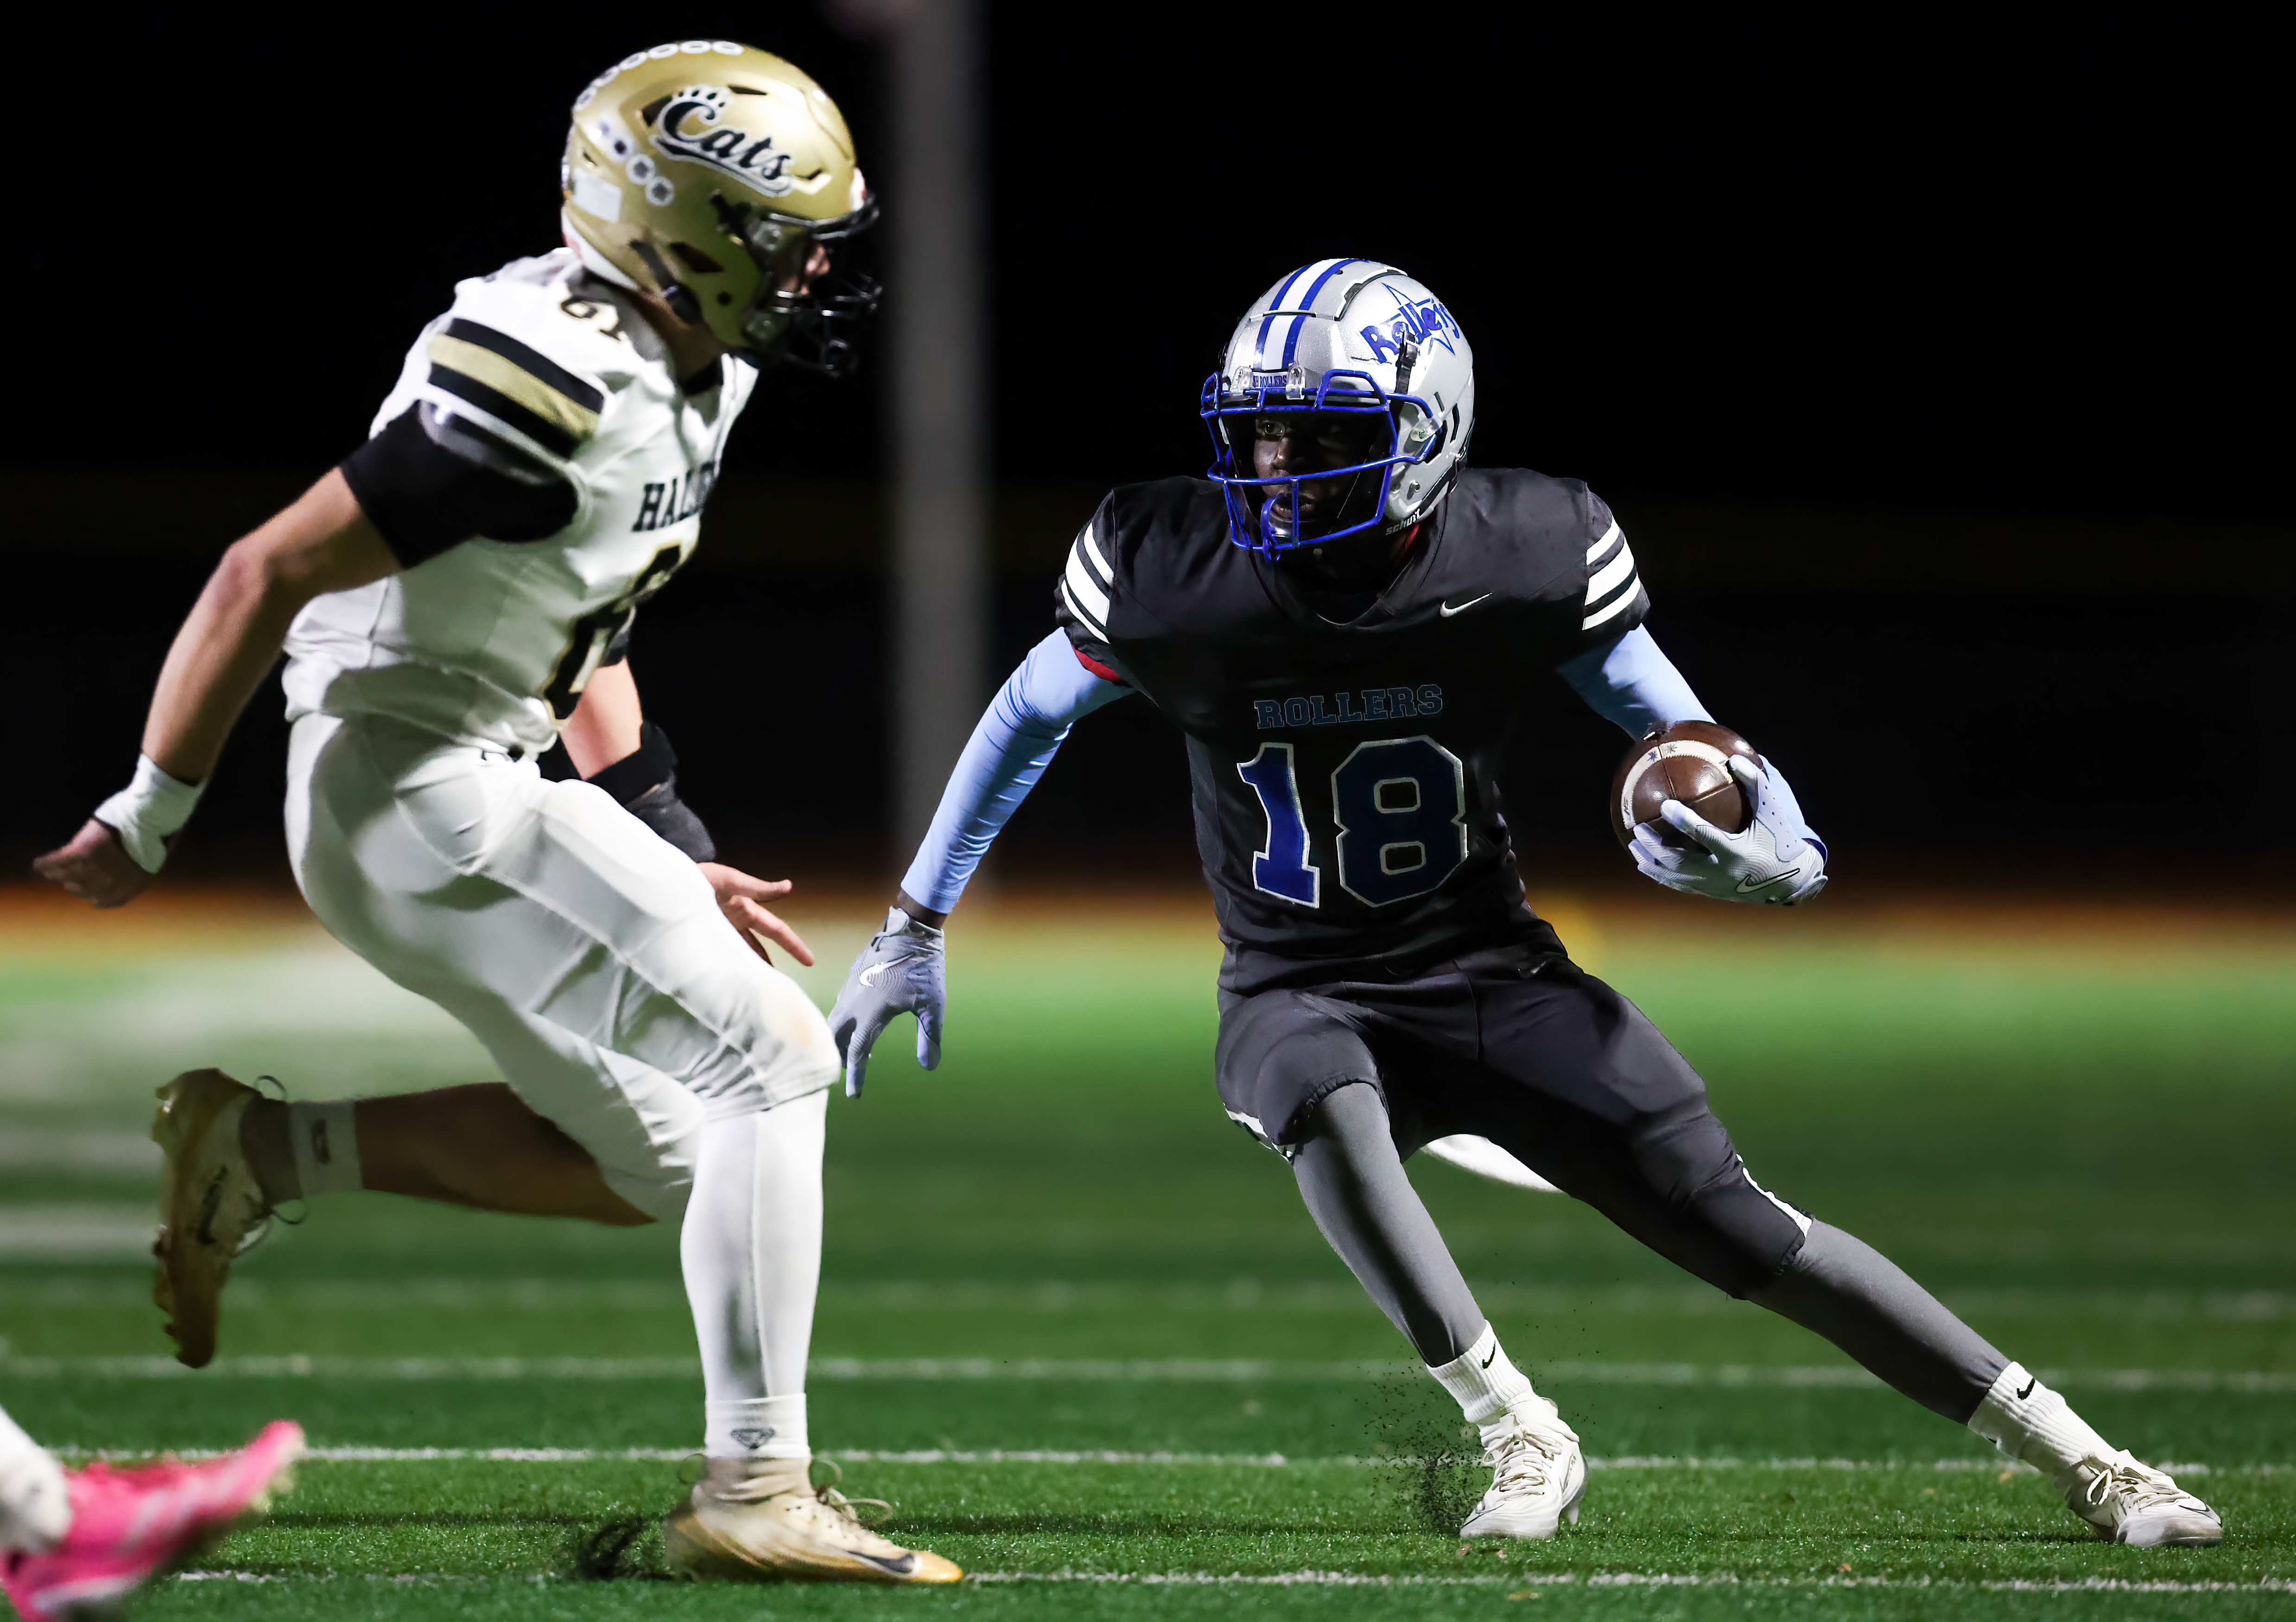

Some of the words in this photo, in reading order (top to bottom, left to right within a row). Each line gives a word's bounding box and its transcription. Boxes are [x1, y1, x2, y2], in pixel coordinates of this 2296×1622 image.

[660, 99, 792, 182] Cats
[1254, 684, 1443, 729] ROLLERS
[1237, 735, 1469, 908] 18
